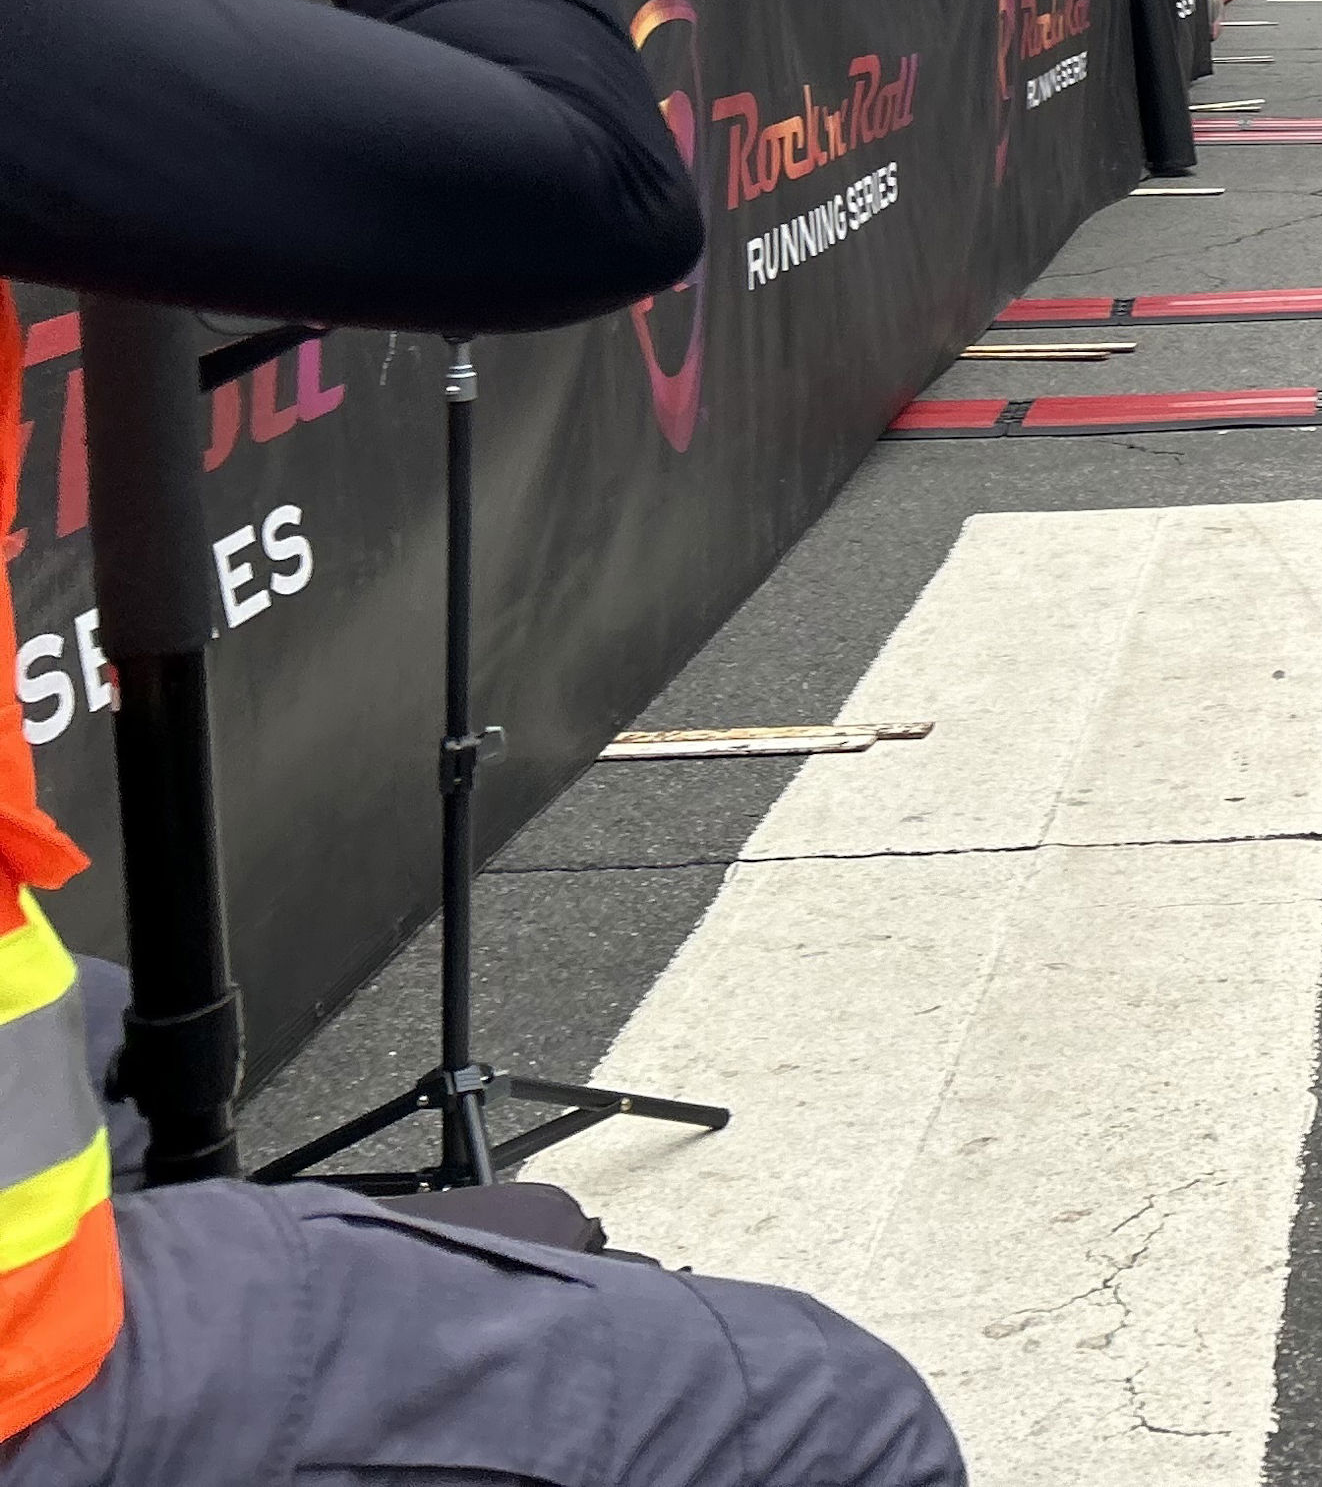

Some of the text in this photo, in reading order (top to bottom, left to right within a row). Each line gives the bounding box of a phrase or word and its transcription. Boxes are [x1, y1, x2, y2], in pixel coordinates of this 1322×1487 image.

[746, 161, 899, 291] RUNNING SERIES
[14, 503, 315, 746] SEES
